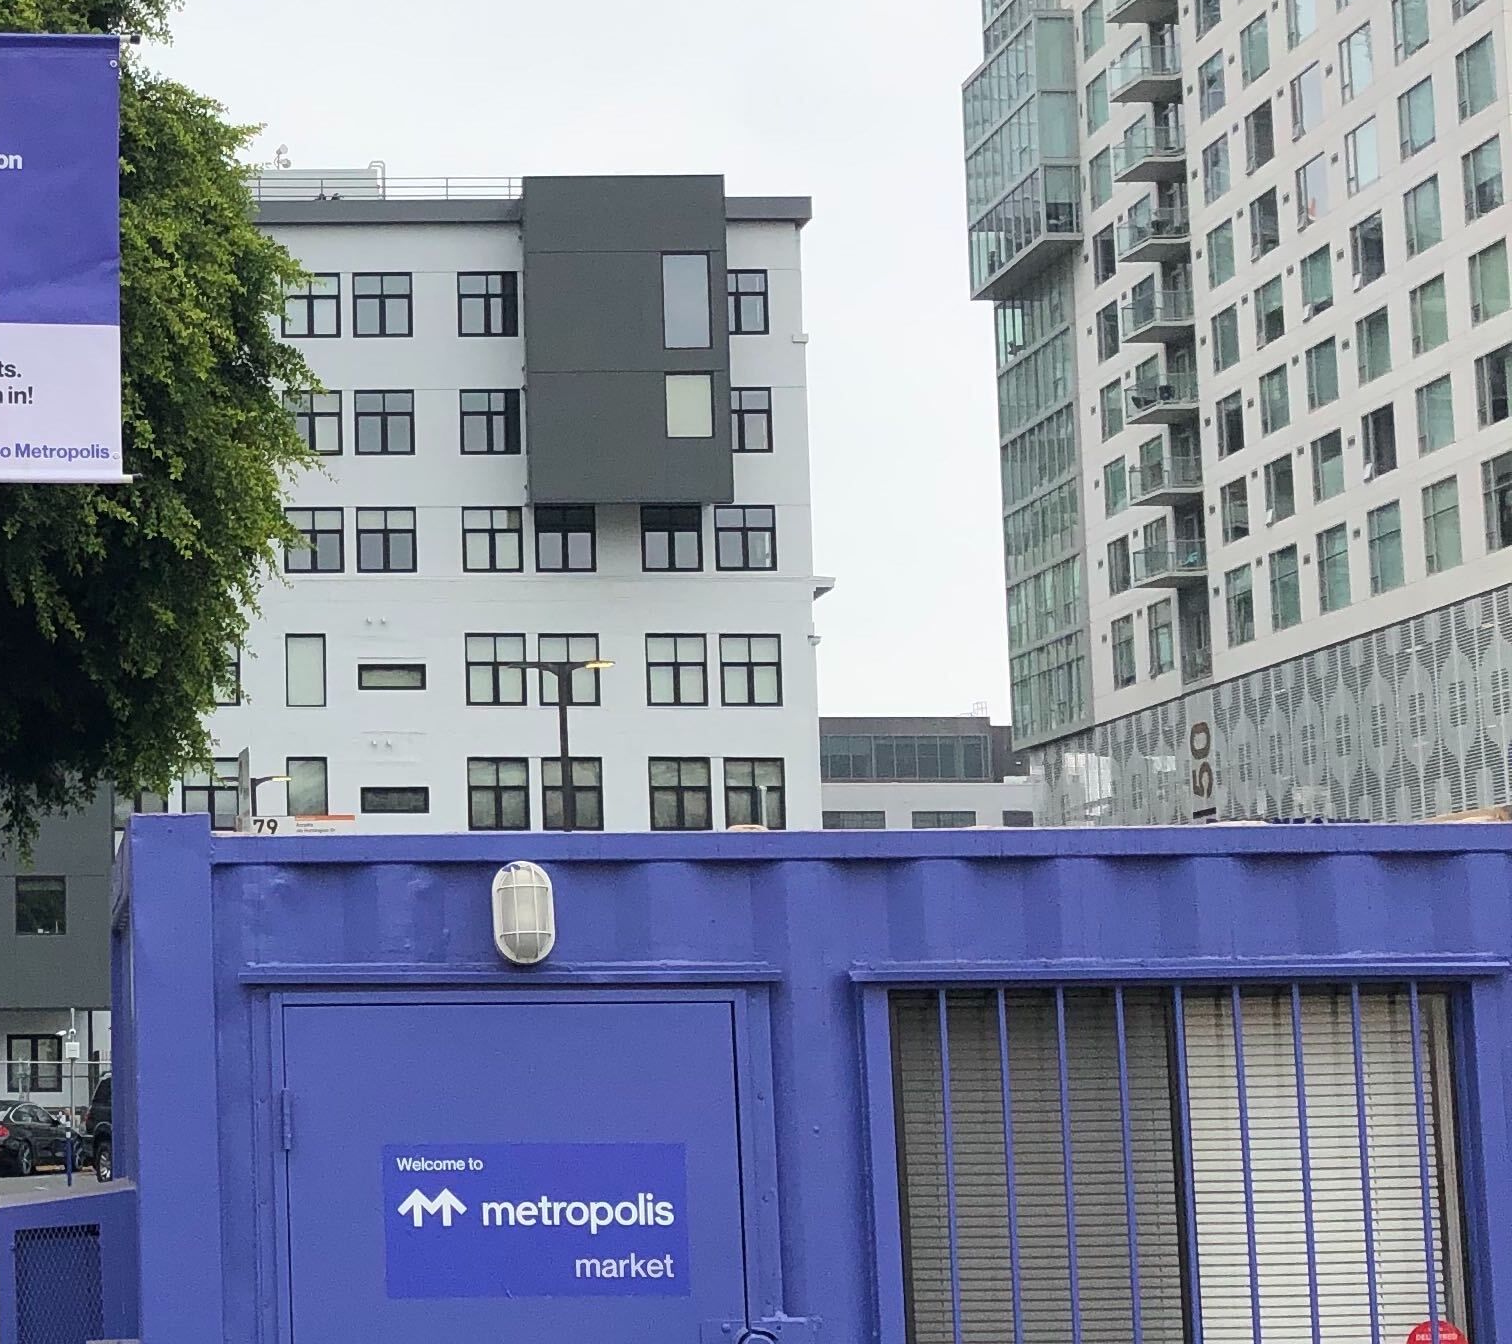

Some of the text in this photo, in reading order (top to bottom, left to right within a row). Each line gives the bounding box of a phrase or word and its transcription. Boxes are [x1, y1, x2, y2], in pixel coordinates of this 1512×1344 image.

[7, 386, 34, 405] in!
[14, 443, 110, 462] Metropolis
[253, 819, 278, 834] 79
[396, 1156, 484, 1171] Welcome to
[481, 1192, 675, 1235] metropolis
[574, 1252, 675, 1278] market
